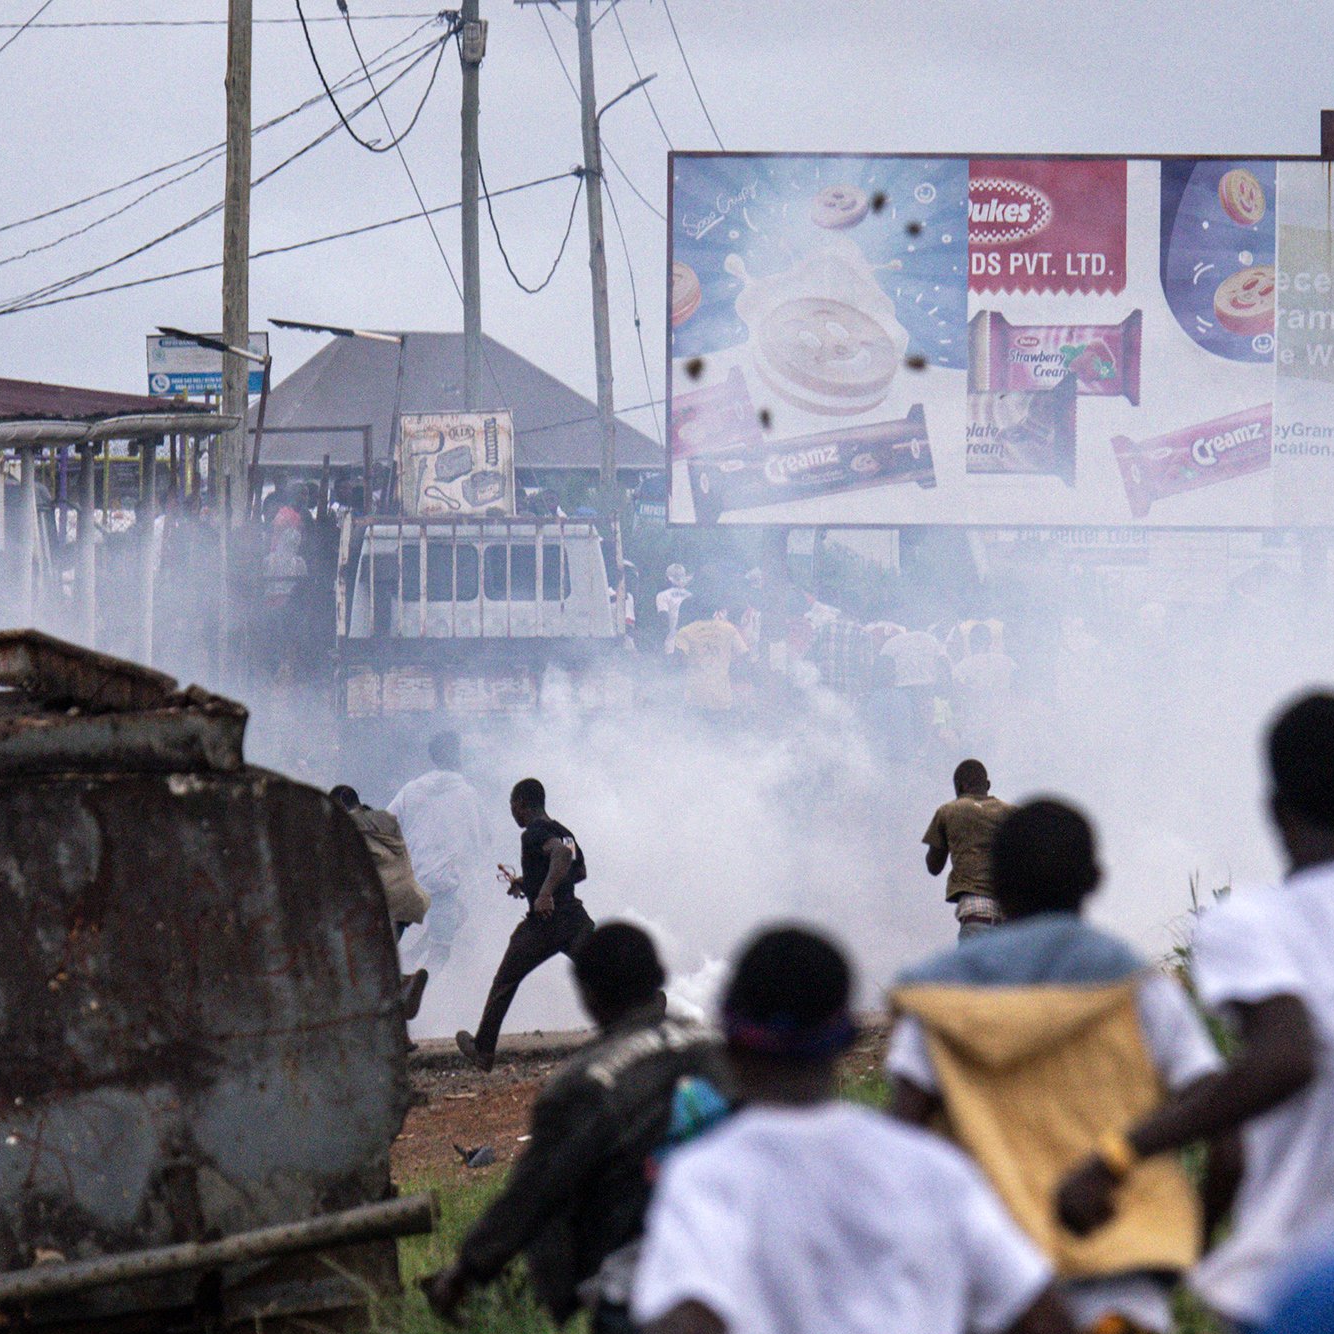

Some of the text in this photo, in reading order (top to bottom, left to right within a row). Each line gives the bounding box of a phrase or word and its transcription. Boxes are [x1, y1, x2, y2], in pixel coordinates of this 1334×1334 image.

[971, 252, 1114, 276] DS PVT. LTD.
[1010, 350, 1065, 367] Strawberry
[1191, 421, 1264, 466] Creamz
[764, 444, 839, 484] Creamz
